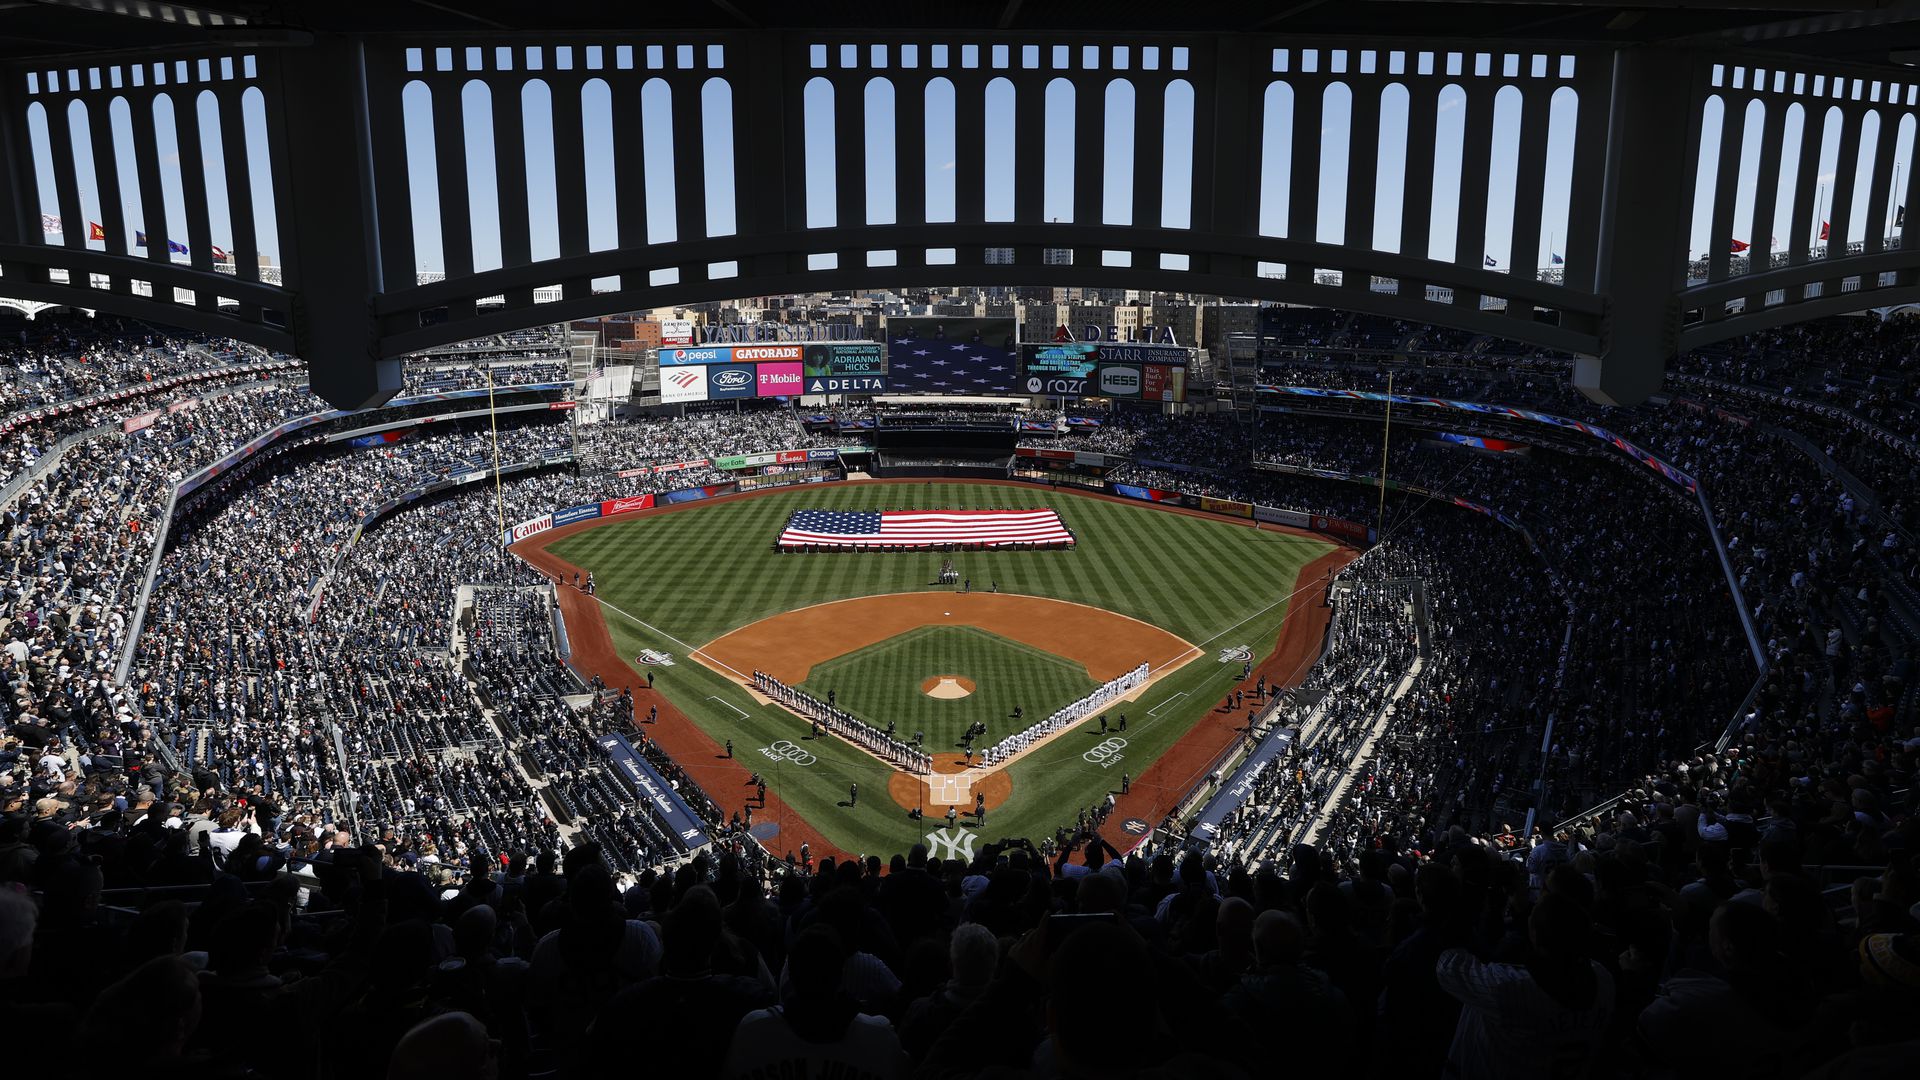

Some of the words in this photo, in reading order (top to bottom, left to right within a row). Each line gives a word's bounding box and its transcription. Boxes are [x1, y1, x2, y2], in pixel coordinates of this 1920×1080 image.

[703, 323, 775, 343] YANKEE
[784, 323, 865, 342] STADIUM
[1085, 325, 1177, 344] DELTA
[688, 350, 716, 362] pepsi
[736, 347, 799, 359] GATORADE
[1099, 349, 1142, 361] STARR
[833, 356, 881, 364] ADRIANNA
[845, 363, 870, 371] HICKS
[719, 373, 746, 384] Ford
[770, 374, 801, 384] Mobile
[829, 378, 882, 390] DELTA
[1103, 375, 1138, 386] HESS
[1047, 380, 1088, 394] razr
[816, 450, 834, 458] coupa
[716, 460, 731, 468] Uber
[731, 459, 745, 467] Eats
[513, 518, 551, 540] Canon
[757, 747, 785, 762] Audi
[1100, 753, 1125, 769] Audi
[925, 826, 979, 864] NY
